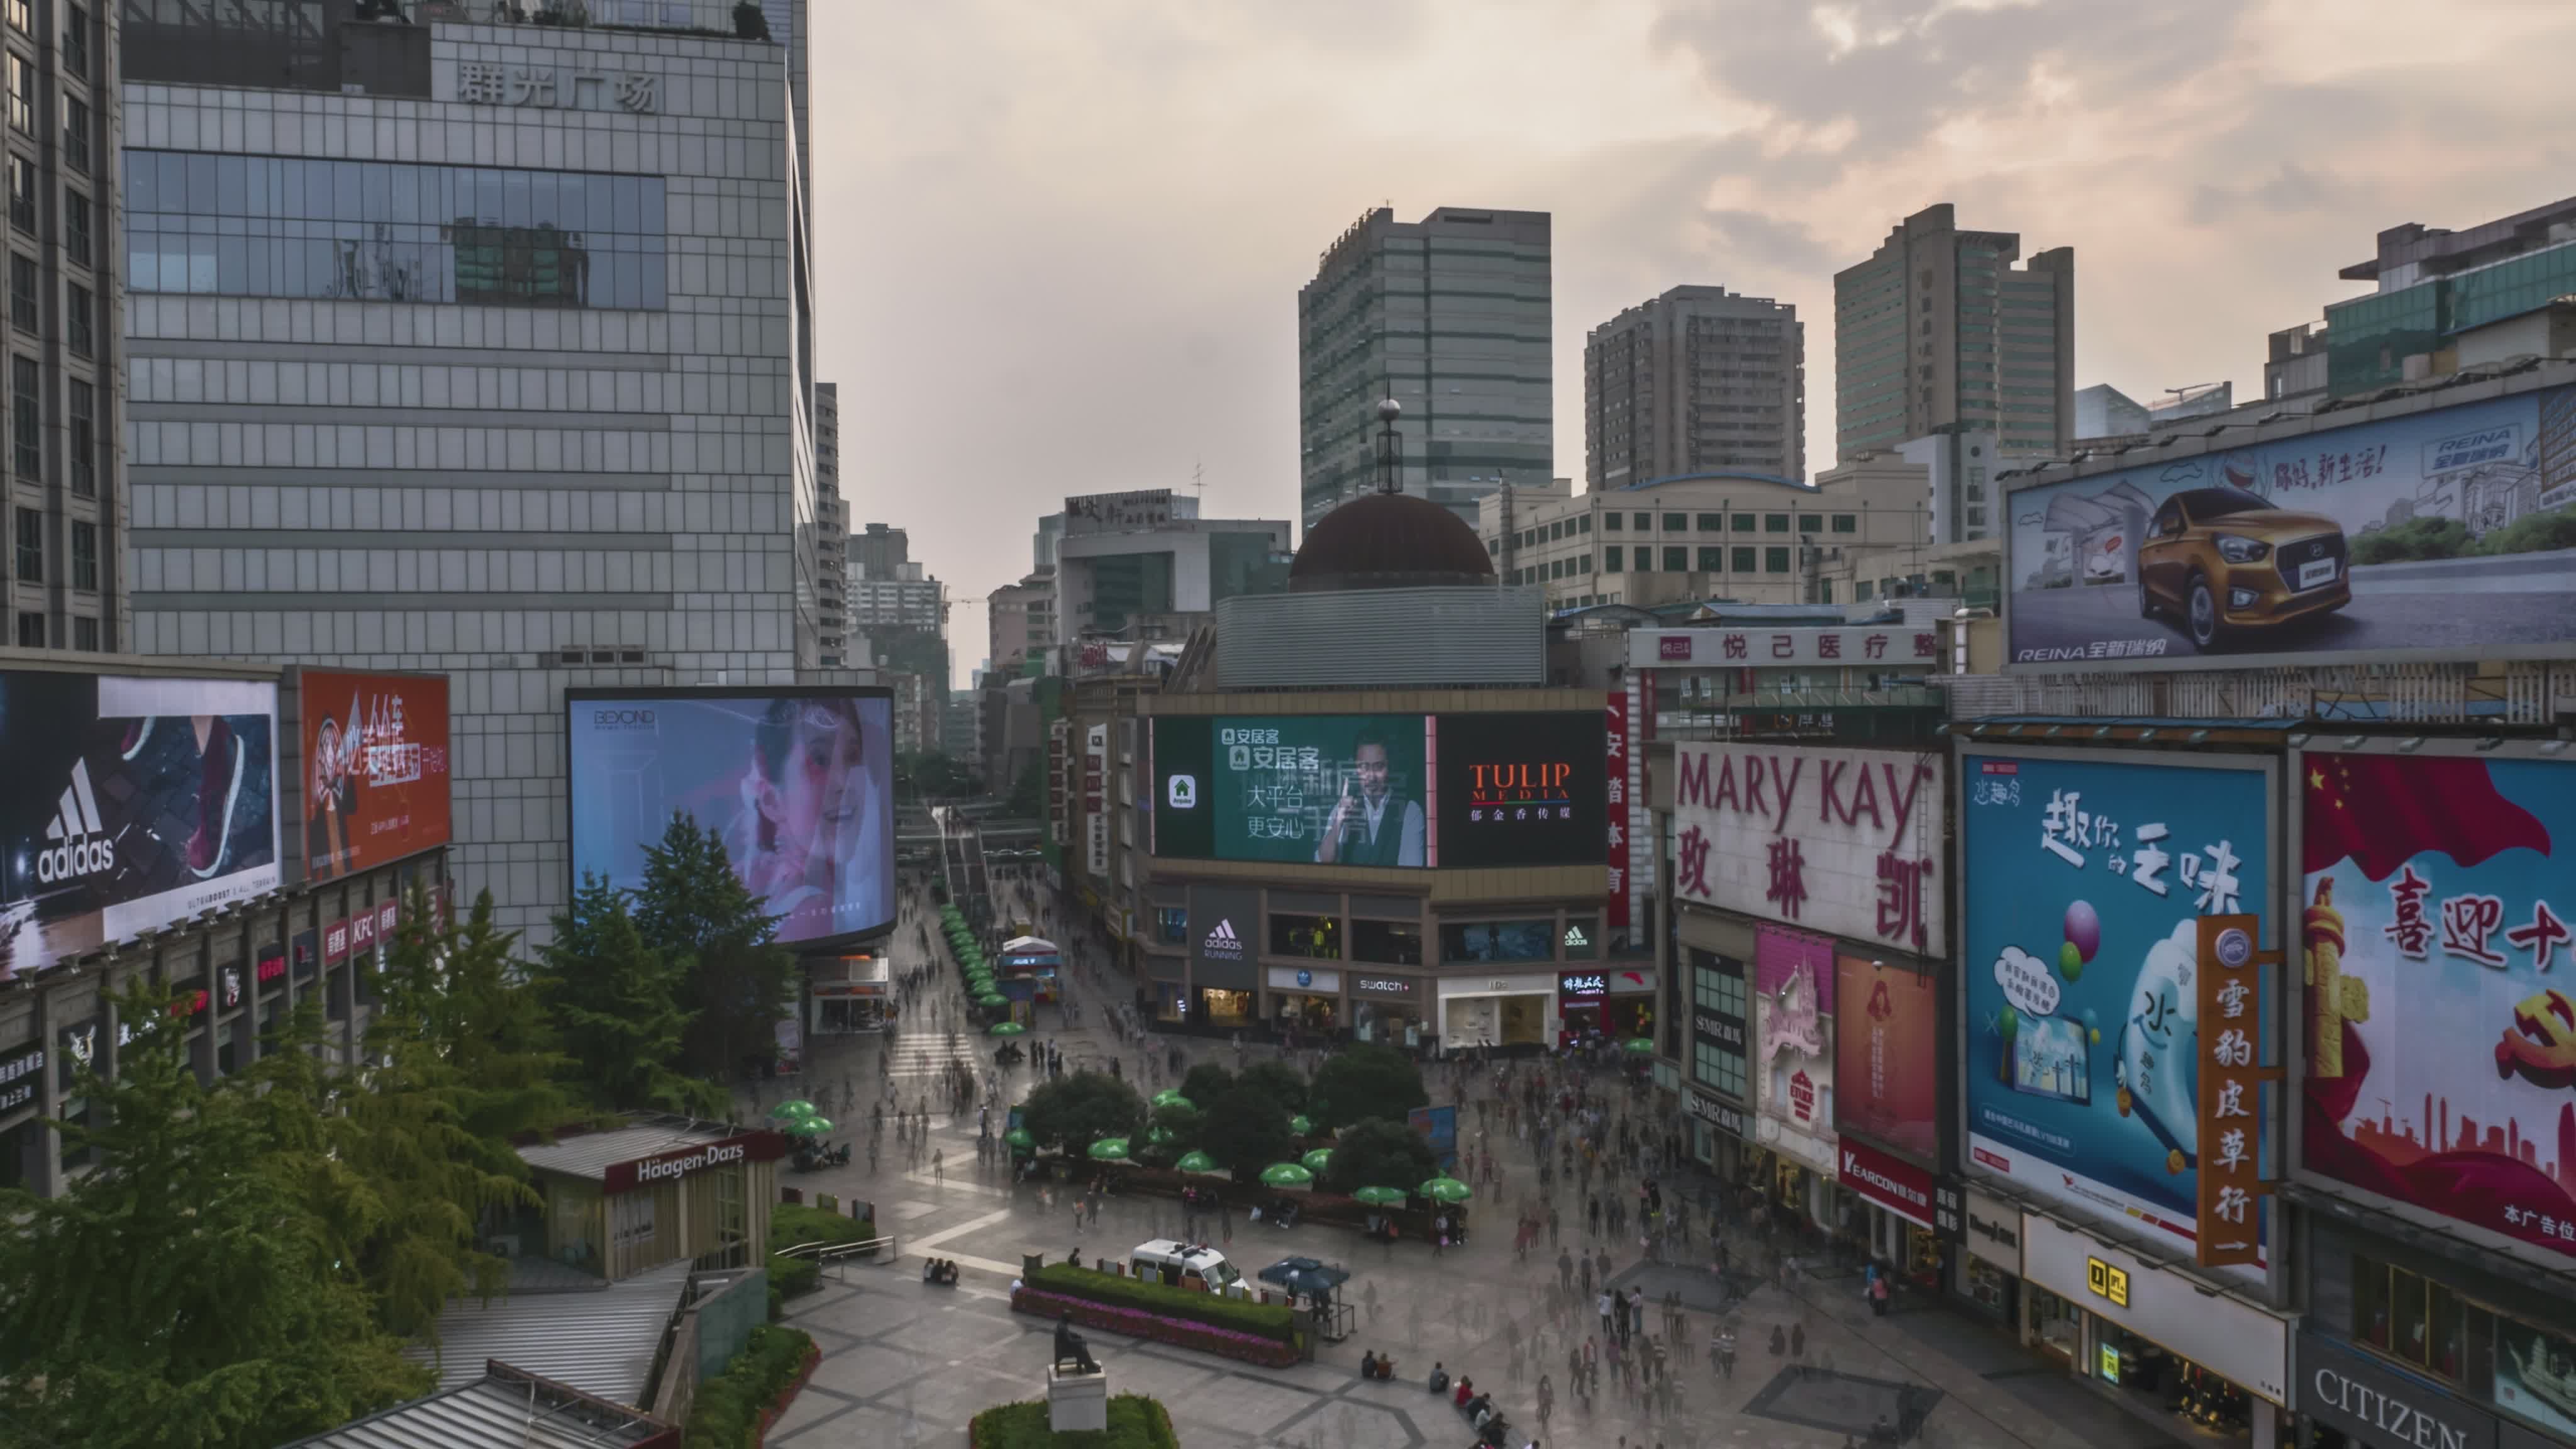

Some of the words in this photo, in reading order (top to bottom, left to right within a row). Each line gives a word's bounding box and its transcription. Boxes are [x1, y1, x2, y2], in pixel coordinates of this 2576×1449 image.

[458, 64, 657, 114] 群光广场
[2438, 428, 2511, 452] REINA
[2018, 647, 2085, 663] REINA
[2087, 638, 2168, 659] 全新瑞纳
[1236, 728, 1279, 745] 安居客
[1252, 746, 1320, 770] 安居客
[1469, 763, 1571, 789] TULIP
[1247, 786, 1304, 810] 大平台
[1472, 789, 1569, 801] MEDIA
[1678, 751, 1802, 834] MARY
[1820, 759, 1926, 852] KAY
[1470, 807, 1571, 821] 郁金香传媒
[1247, 816, 1305, 840] 更安心
[38, 832, 114, 883] adidas
[1677, 824, 1928, 948] 玫琳凯
[353, 915, 374, 943] KFC
[2384, 863, 2576, 973] 喜迎十
[1204, 934, 1243, 951] adidas
[1204, 950, 1243, 961] RUNNING
[1359, 978, 1402, 992] swatch
[2212, 979, 2253, 1224] 雪豹皮草行
[1843, 1150, 1897, 1195] YEARCON
[2503, 1204, 2576, 1242] 本广告位
[2315, 1367, 2468, 1449] CITIZEN
